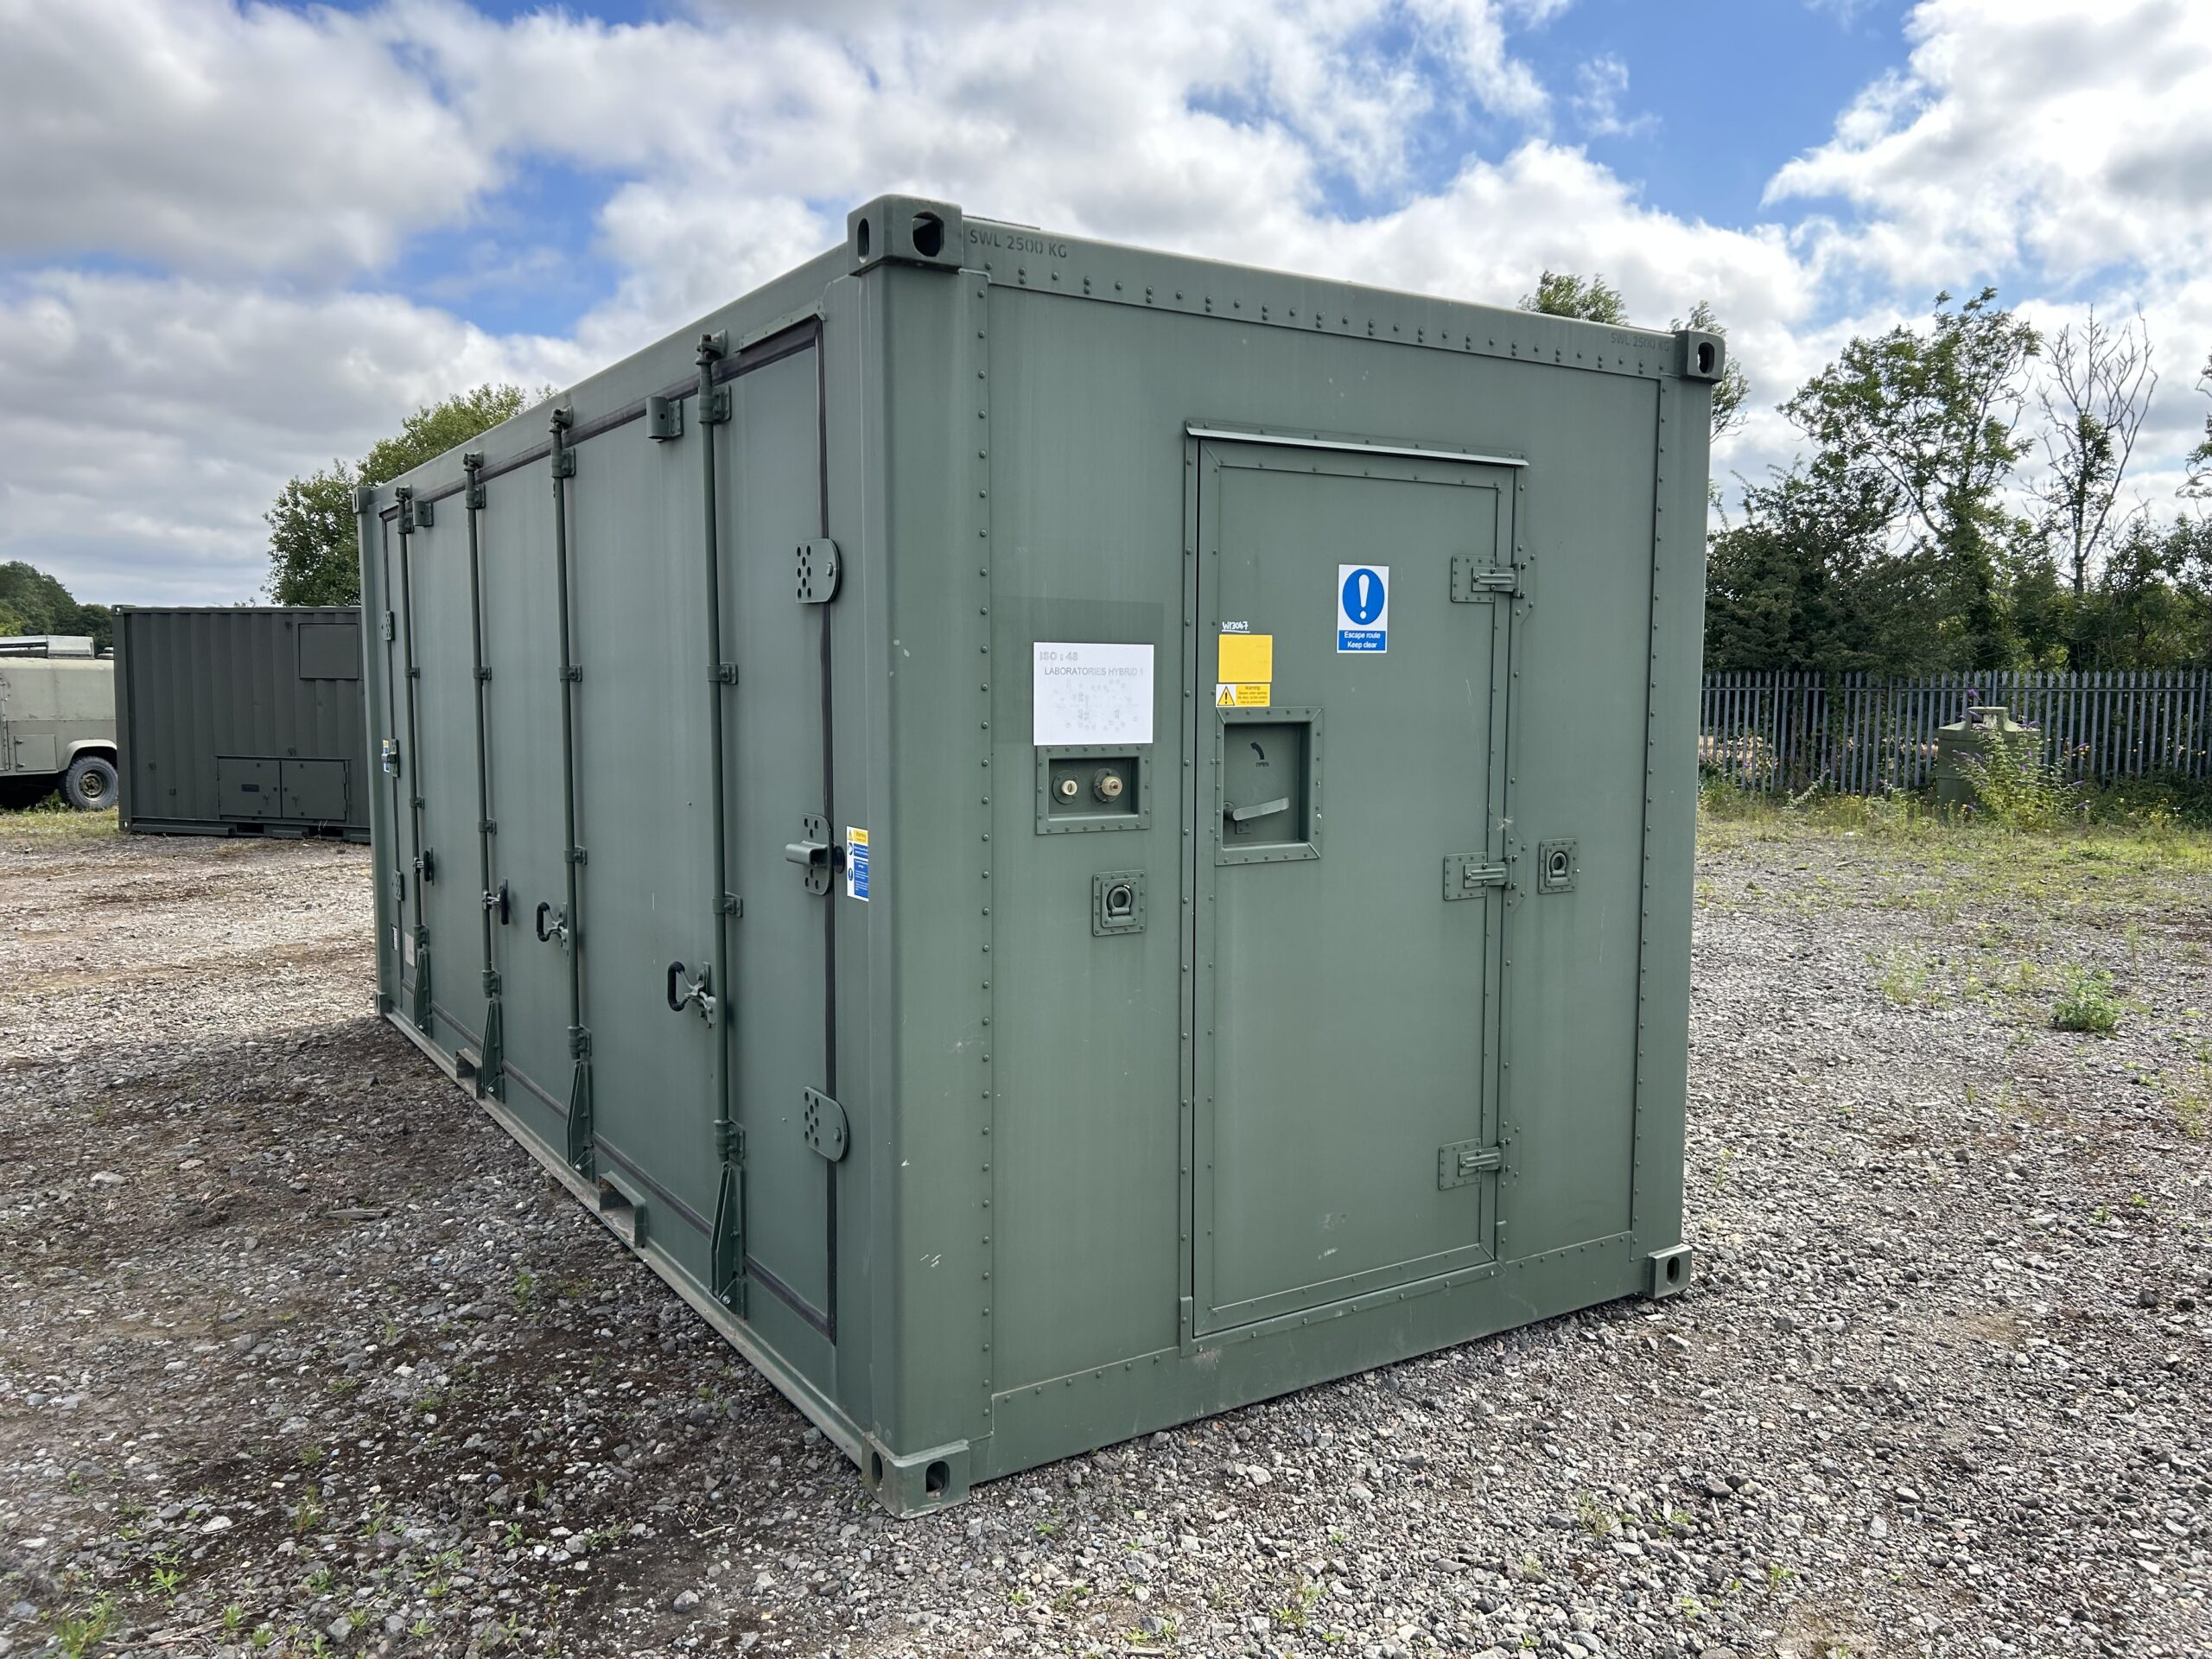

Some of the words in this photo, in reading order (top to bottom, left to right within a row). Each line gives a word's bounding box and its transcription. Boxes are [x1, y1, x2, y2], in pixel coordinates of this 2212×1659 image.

[969, 229, 1001, 248] SWL
[1007, 235, 1044, 255] 2500
[1048, 243, 1067, 258] KG
[1611, 332, 1630, 346] SWL
[1632, 335, 1656, 350] 2500
[1658, 340, 1669, 352] KG
[1344, 631, 1365, 639] Escape
[1347, 640, 1363, 649] Keep
[1039, 651, 1058, 661] ISO
[1045, 666, 1107, 676] LABORATORIES
[1109, 667, 1138, 677] HYBRID
